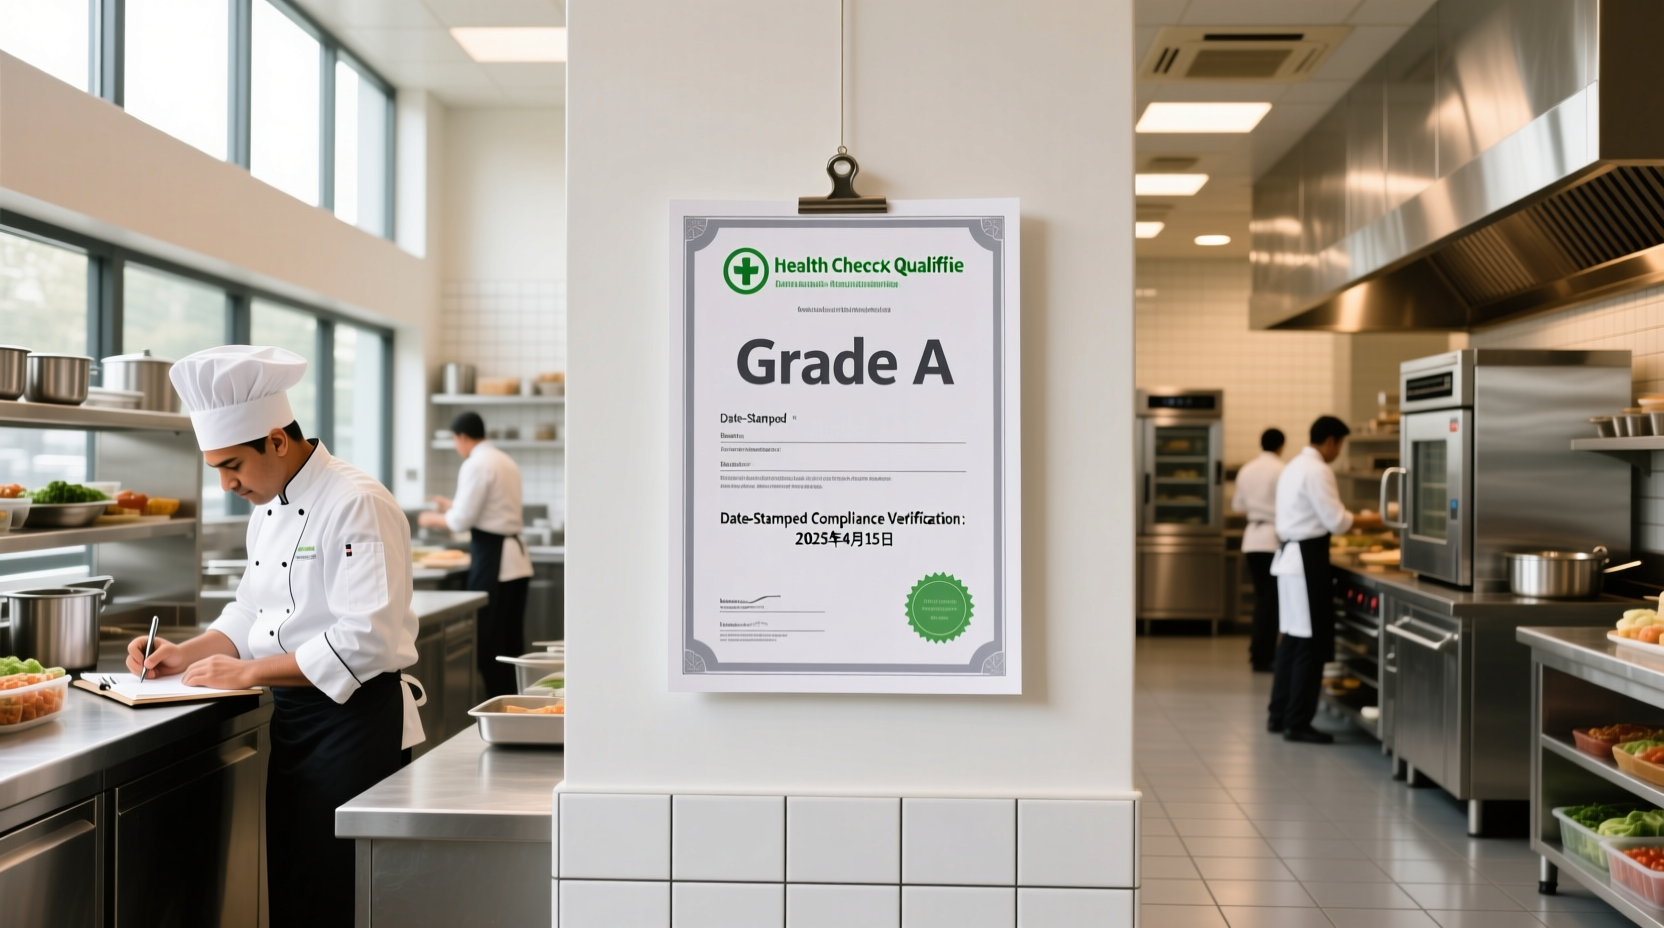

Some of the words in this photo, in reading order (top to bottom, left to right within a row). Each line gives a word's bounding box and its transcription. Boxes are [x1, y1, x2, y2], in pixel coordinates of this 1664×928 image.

[774, 255, 828, 273] Health
[736, 336, 898, 386] Grade
[912, 338, 955, 386] A
[720, 511, 808, 529] Date-Stamped
[811, 511, 886, 529] Compliance
[887, 510, 966, 526] Verification:
[794, 529, 893, 548] 2025年4月15日
